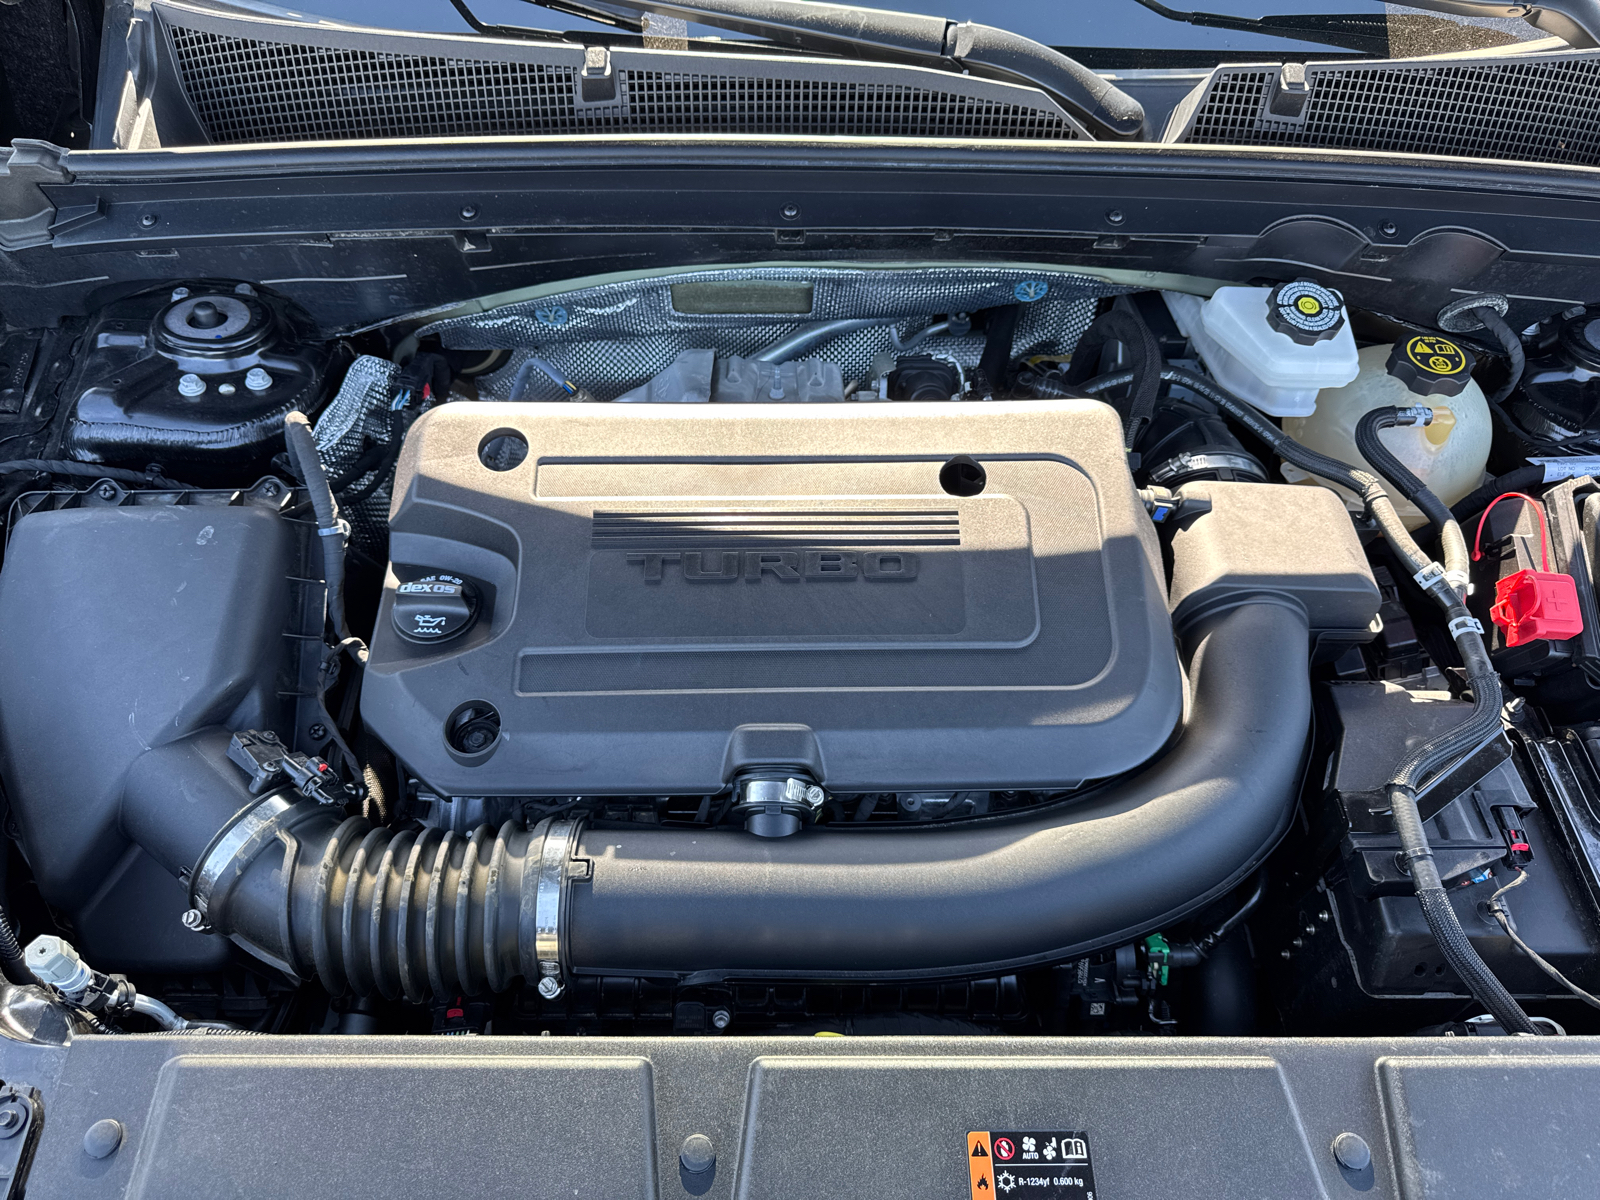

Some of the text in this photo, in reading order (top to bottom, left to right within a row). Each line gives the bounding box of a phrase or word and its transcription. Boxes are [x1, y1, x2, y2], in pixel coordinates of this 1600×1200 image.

[626, 551, 918, 583] TURBO
[439, 575, 463, 584] 0W-20
[400, 582, 456, 594] dexos
[1022, 1152, 1039, 1160] AUTO
[1018, 1177, 1084, 1187] R-1234yf 0.600 kg
